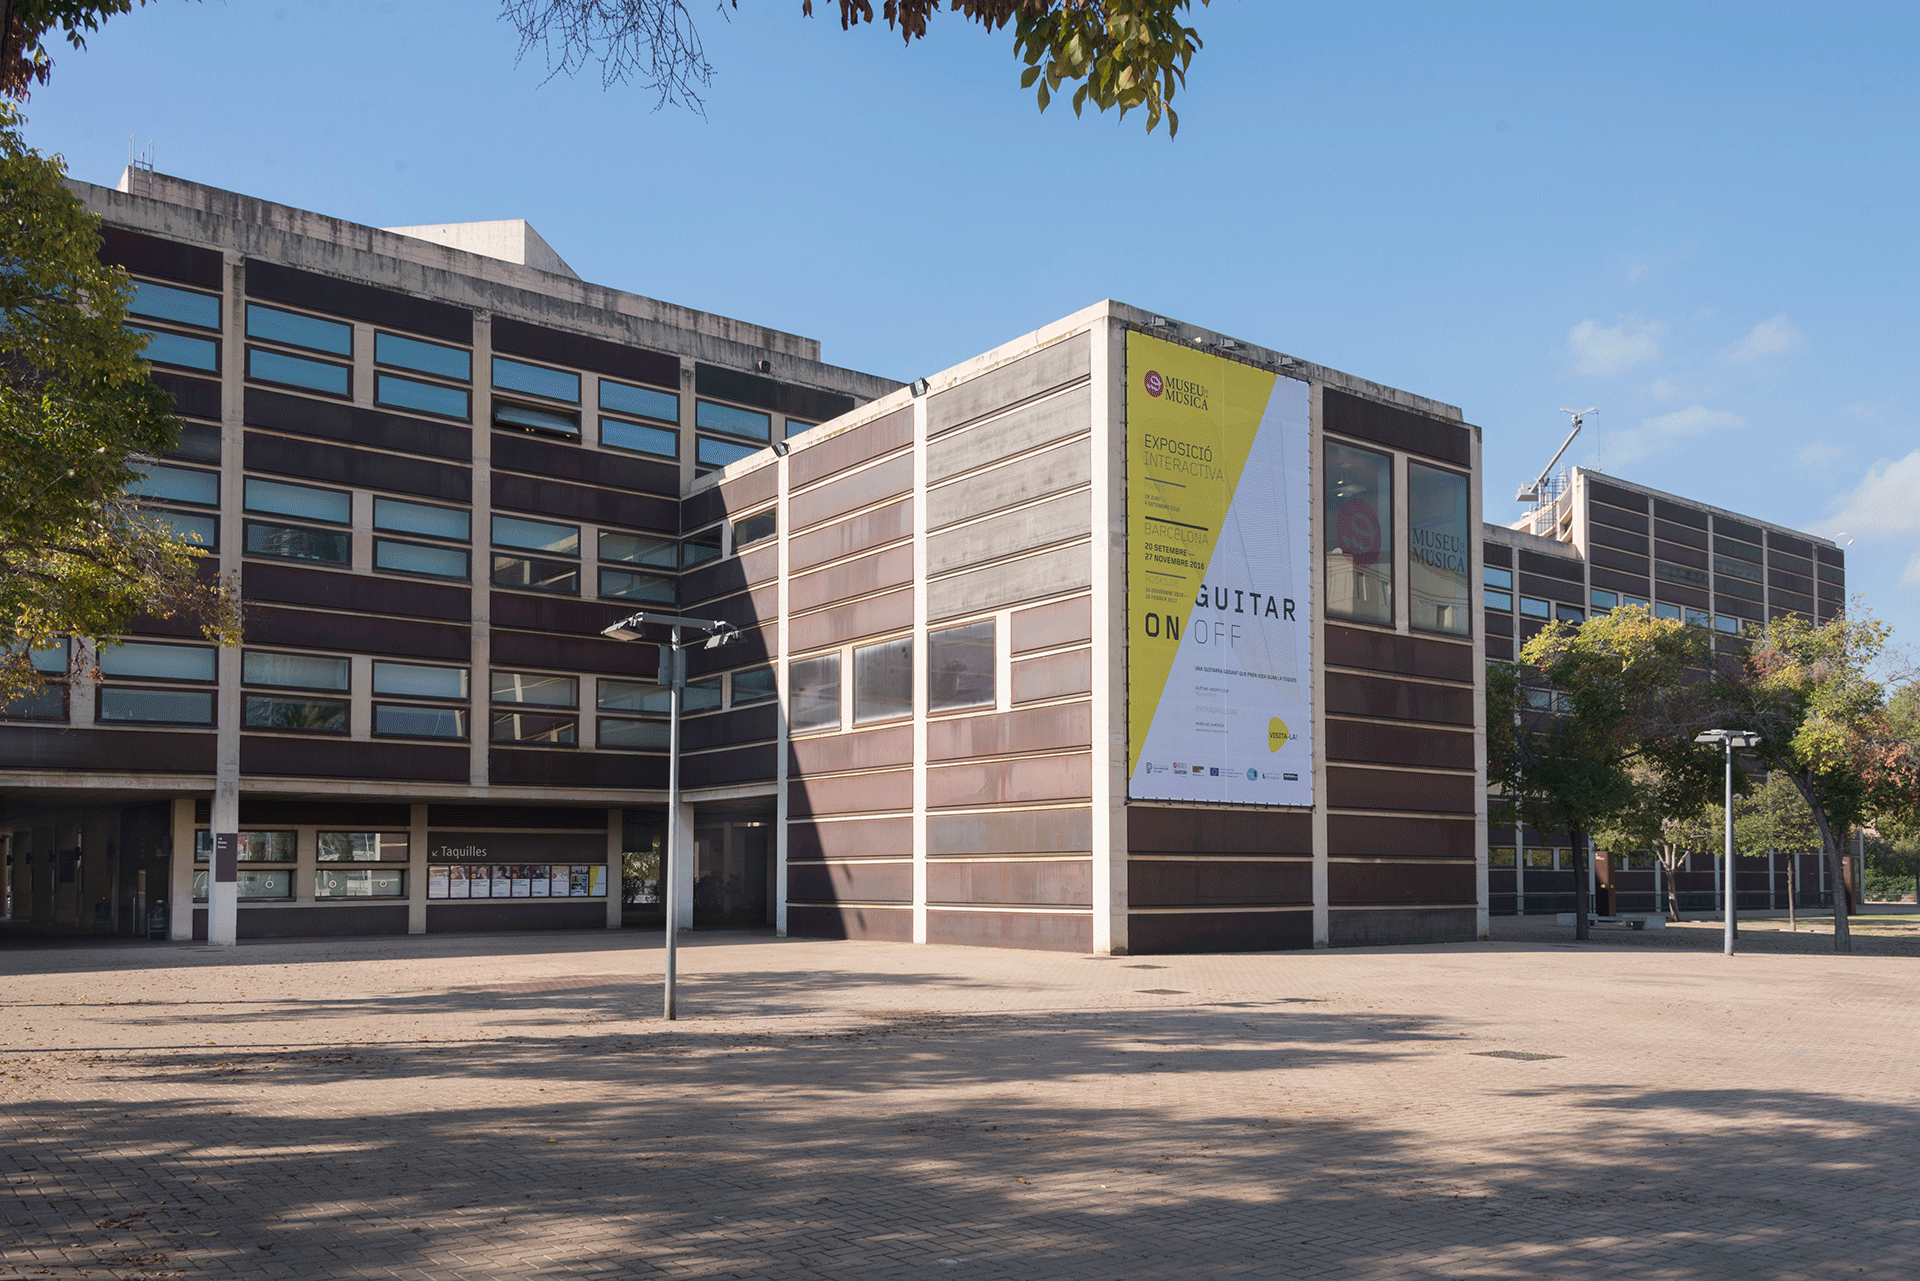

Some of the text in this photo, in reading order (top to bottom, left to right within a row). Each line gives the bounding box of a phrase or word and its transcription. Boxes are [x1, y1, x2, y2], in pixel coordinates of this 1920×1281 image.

[1165, 375, 1204, 397] MUSEU
[1165, 388, 1208, 411] MÚSICA
[1144, 433, 1213, 463] EXPOSICIÓ
[1144, 450, 1225, 482] INTERACTIVA
[1144, 521, 1210, 546] BARCELONA
[1411, 527, 1460, 553] MUSEU
[1144, 542, 1153, 551] 20
[1154, 543, 1188, 557] SETEMBRE
[1144, 552, 1205, 571] 27 NOVEMBRE 2016
[1411, 546, 1466, 573] MÚSICA
[1195, 583, 1296, 622] GUITAR
[1144, 611, 1242, 649] ON OFF
[441, 845, 487, 860] Taquilles
